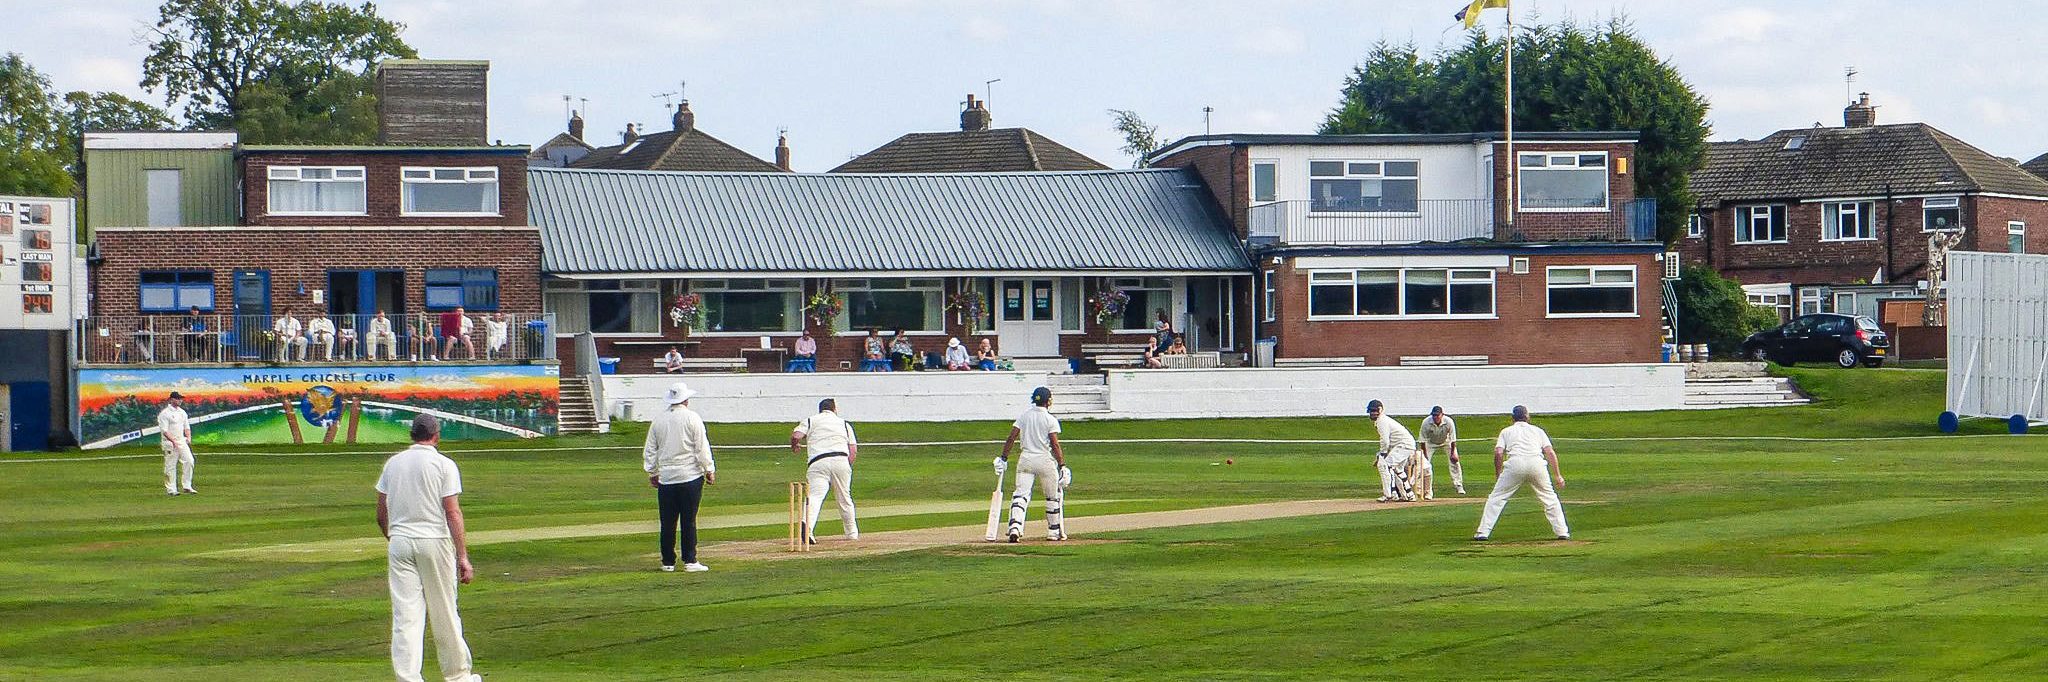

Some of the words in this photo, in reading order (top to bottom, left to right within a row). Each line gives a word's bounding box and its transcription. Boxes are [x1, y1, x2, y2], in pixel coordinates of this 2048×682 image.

[243, 374, 293, 383] MARPLE
[301, 373, 357, 383] CRICKET
[364, 373, 396, 382] CLUB
